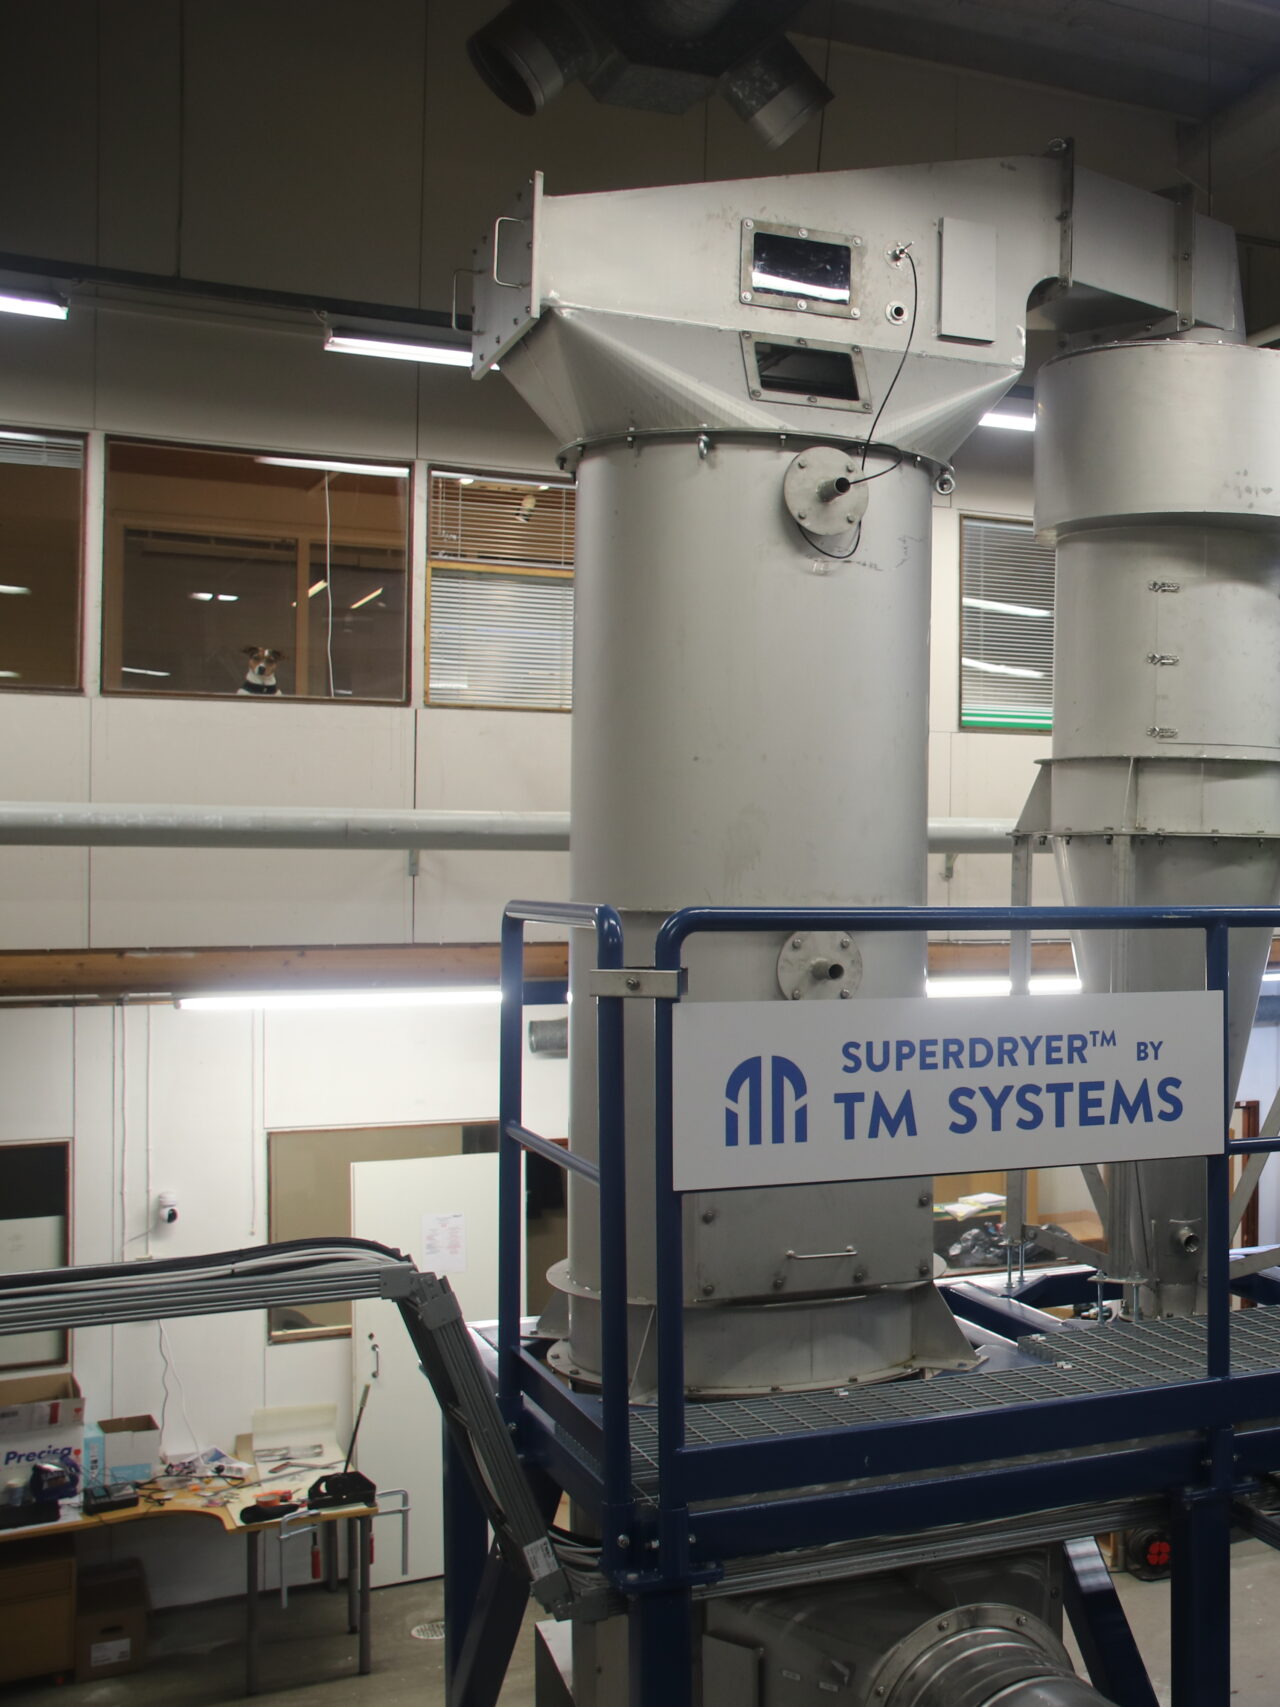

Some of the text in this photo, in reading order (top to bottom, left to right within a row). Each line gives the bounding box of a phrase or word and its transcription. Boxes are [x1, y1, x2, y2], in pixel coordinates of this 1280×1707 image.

[1136, 1040, 1164, 1062] BY
[833, 1076, 1184, 1140] TM SYSTEMS
